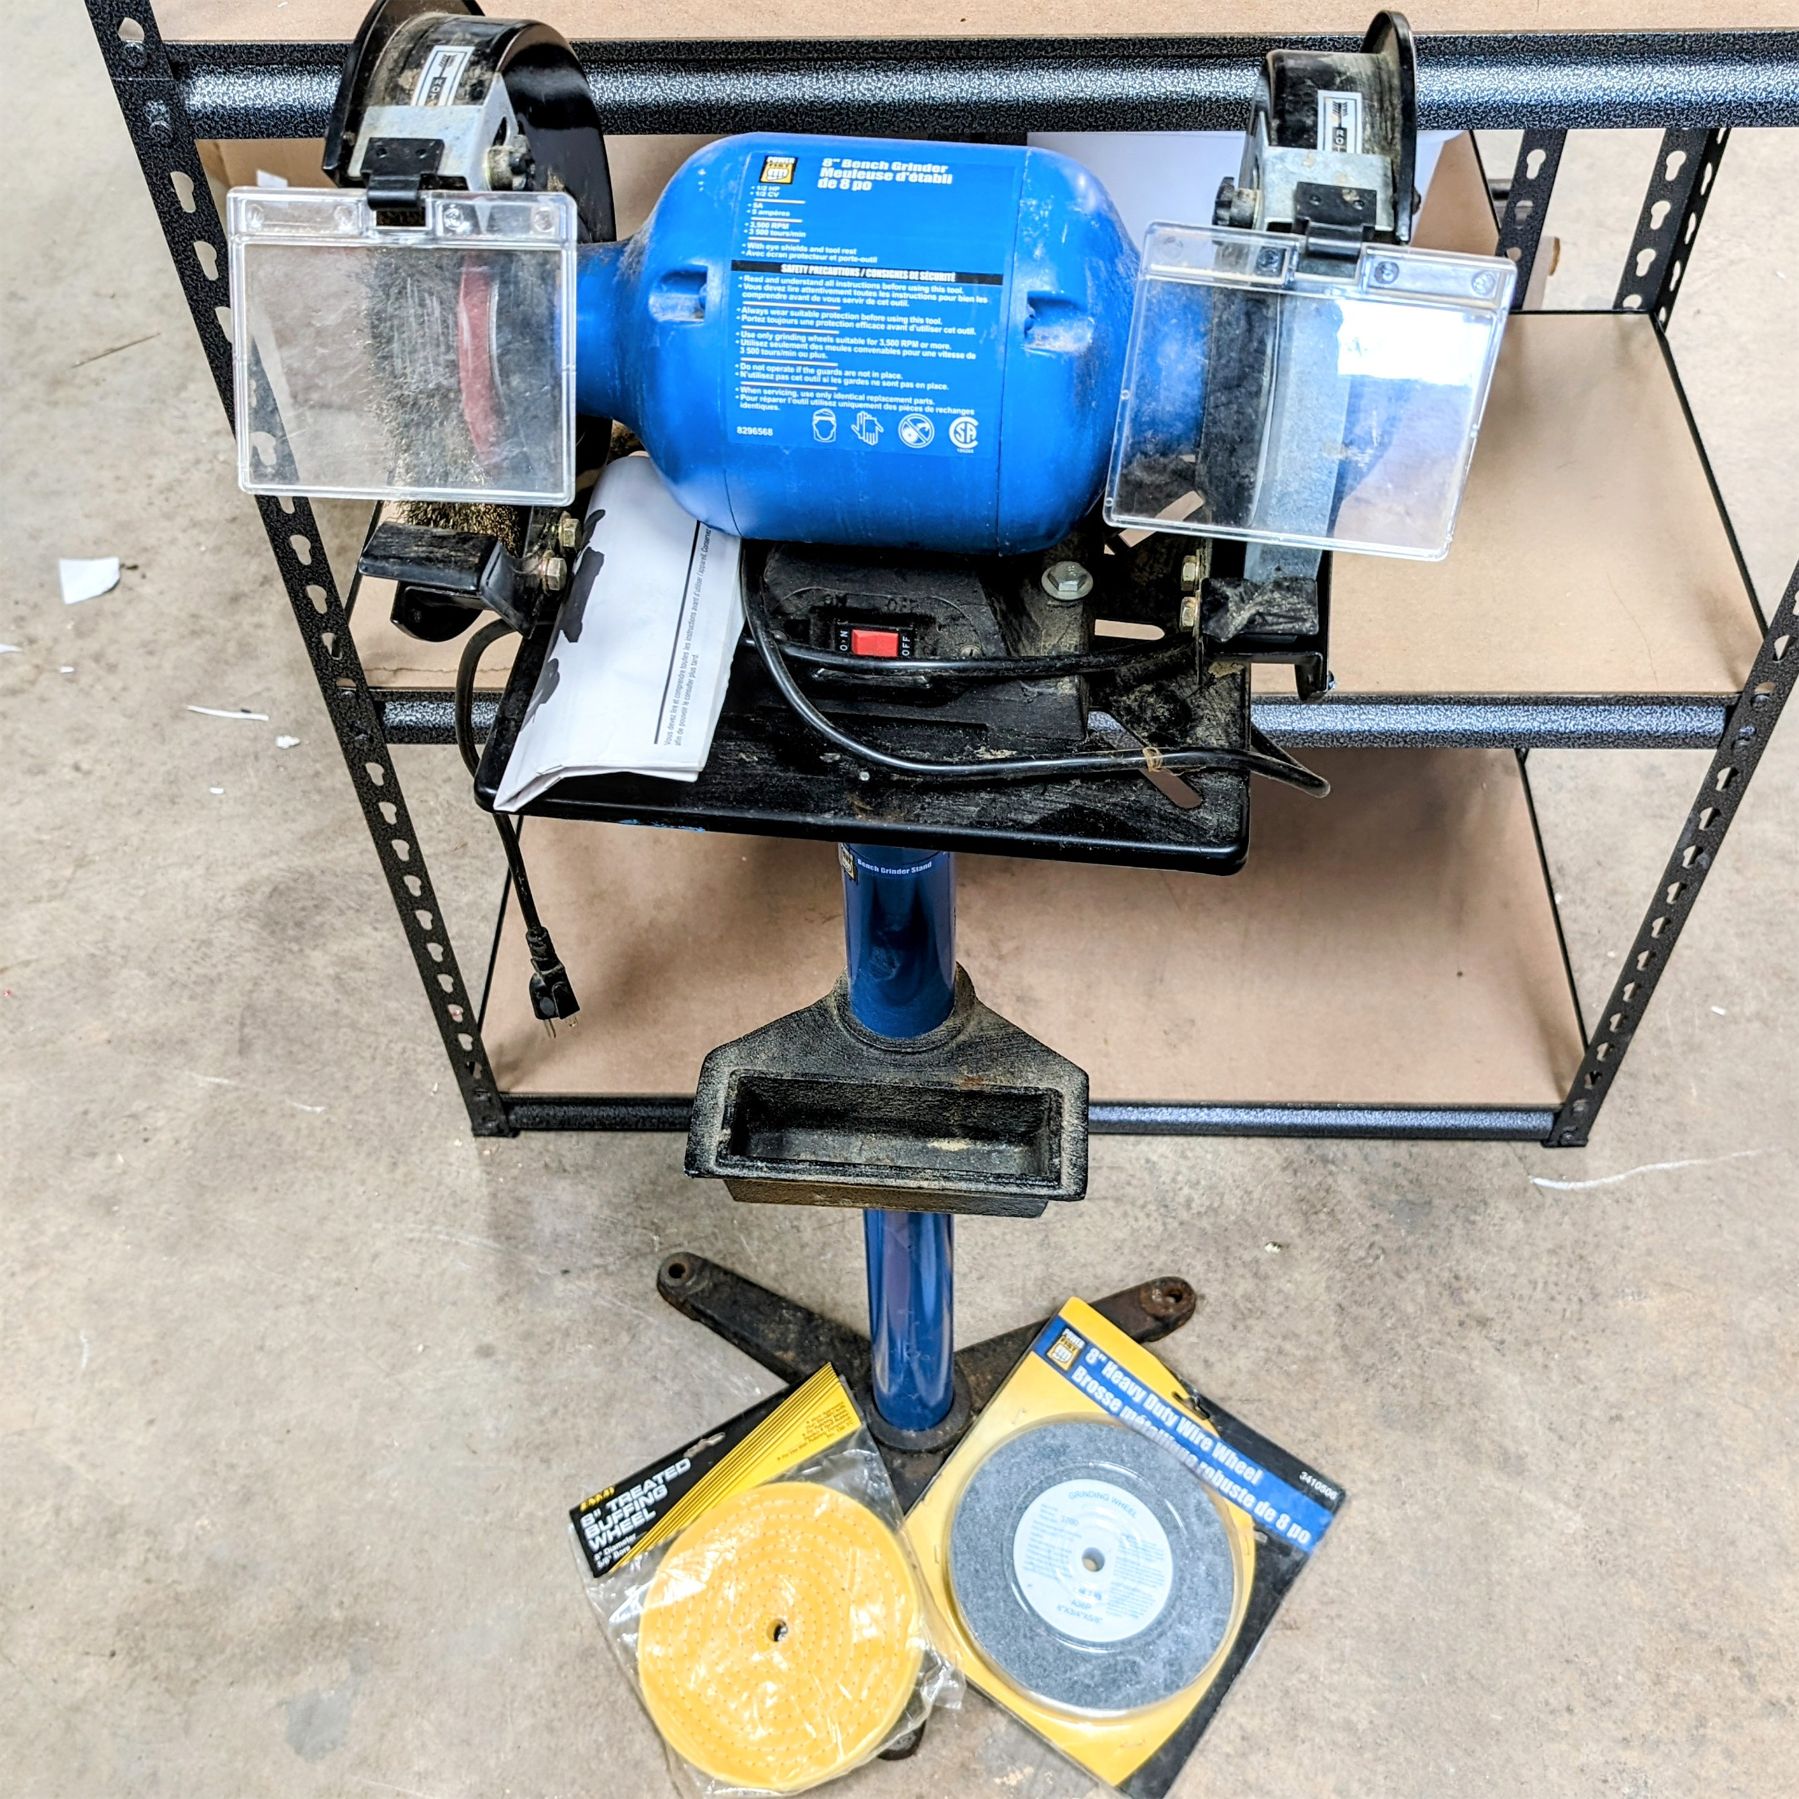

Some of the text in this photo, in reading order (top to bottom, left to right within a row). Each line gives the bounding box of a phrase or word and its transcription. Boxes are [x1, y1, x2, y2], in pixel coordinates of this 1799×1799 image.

[820, 166, 952, 184] Meuleuse d'établi
[841, 159, 889, 170] Bench
[891, 162, 948, 173] Grinder
[818, 177, 872, 190] de 8 po
[781, 264, 808, 273] SAFETY
[808, 265, 860, 276] PRECAUTIONS
[866, 268, 908, 279] CONSIGNES
[840, 630, 848, 651] ON
[902, 636, 910, 656] OFF
[857, 858, 932, 875] Bench Grinder Stand
[1086, 1347, 1264, 1486] 8" Heavy Duty Wire Wheel
[1071, 1365, 1123, 1413] Brosse
[1197, 1461, 1257, 1508] robuste
[1254, 1500, 1277, 1522] de
[1275, 1513, 1291, 1531] 8
[1286, 1522, 1312, 1544] po
[605, 1458, 691, 1511] TREATED
[584, 1484, 668, 1539] BUFFING
[1068, 1490, 1137, 1518] GRINDING WHEEL
[588, 1508, 656, 1552] WHEEL
[603, 1533, 636, 1555] Diameter
